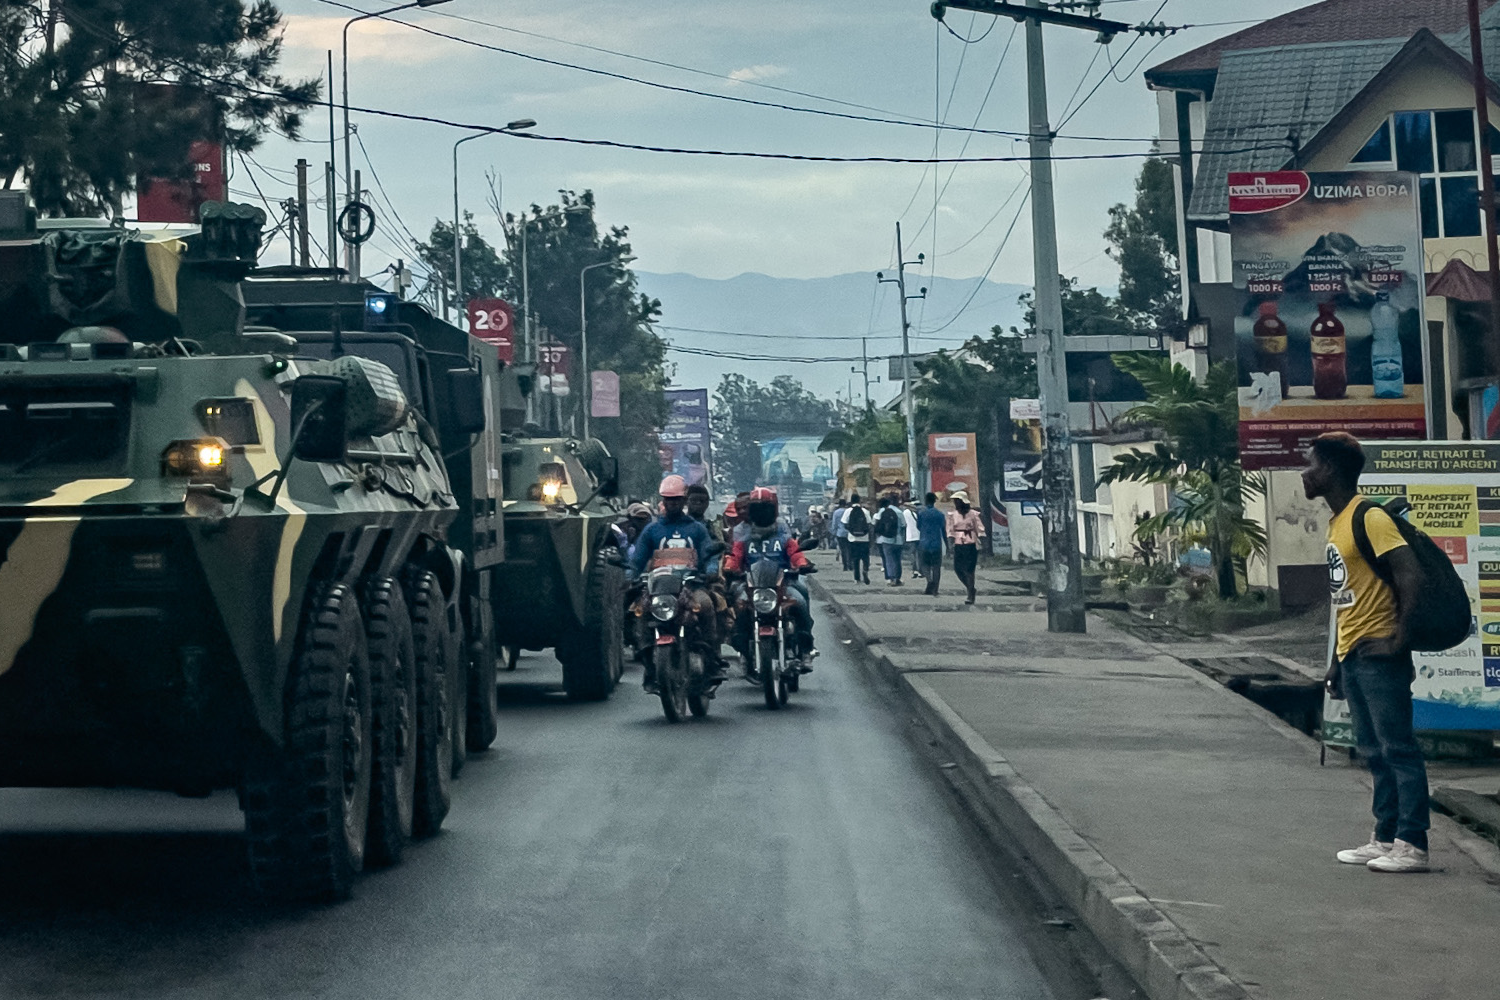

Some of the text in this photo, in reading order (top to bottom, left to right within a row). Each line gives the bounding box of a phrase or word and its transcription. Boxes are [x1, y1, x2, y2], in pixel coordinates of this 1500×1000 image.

[1314, 184, 1408, 199] UZIMA BORA
[1249, 284, 1271, 292] 1000
[1310, 283, 1331, 291] 1000
[475, 309, 508, 331] 20
[1381, 449, 1486, 460] DEPOT, RETRAIT ET
[1374, 460, 1497, 469] TRANSFERT D'ARGENT
[1357, 486, 1403, 494] ANZANIE
[1409, 493, 1471, 501] TRANSFERT
[1416, 511, 1470, 520] D'ARGENT
[1438, 668, 1482, 677] StarTimes
